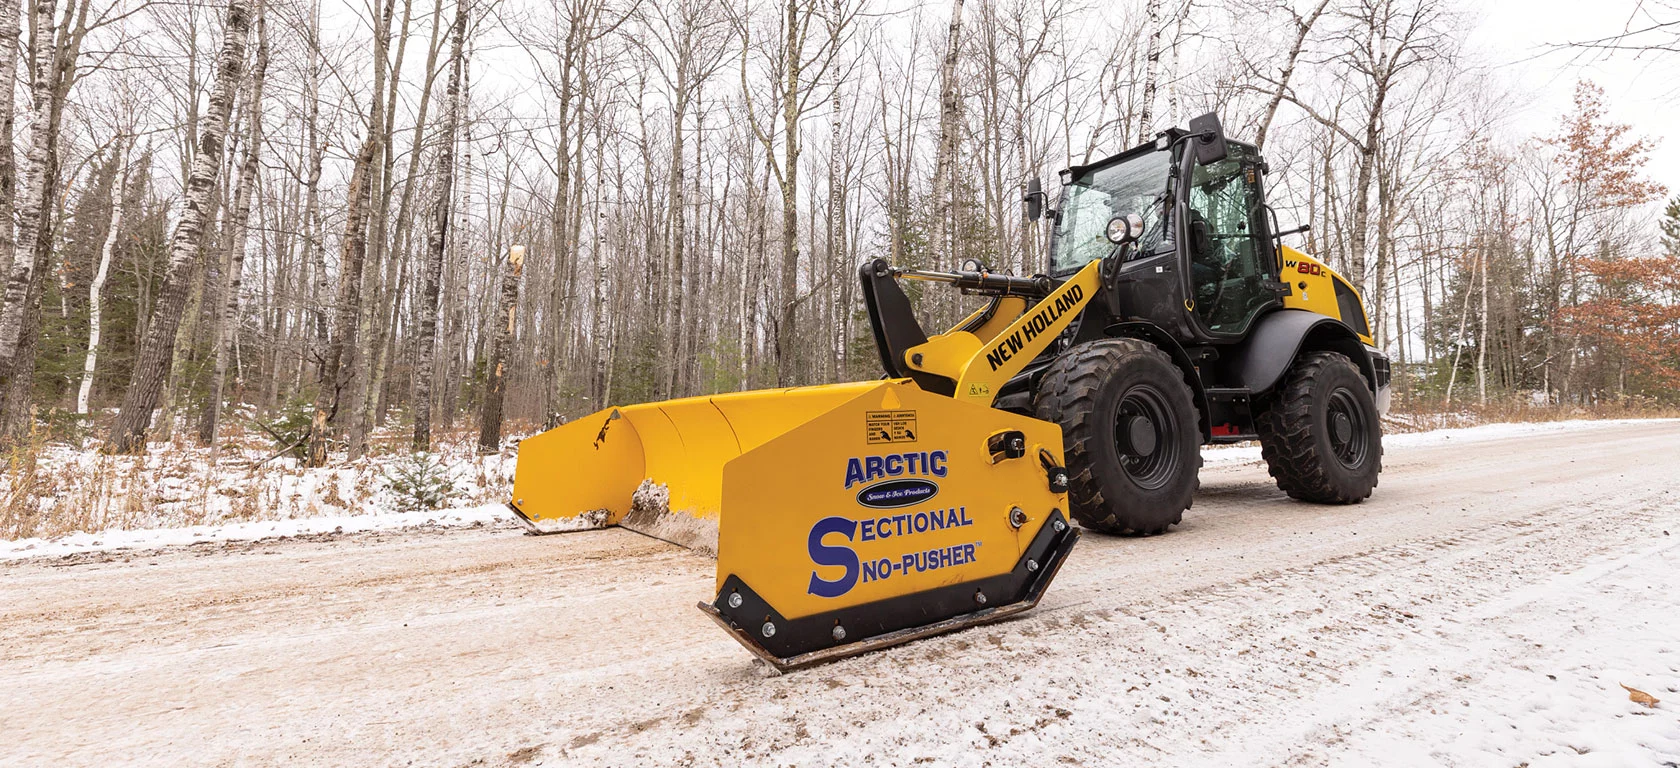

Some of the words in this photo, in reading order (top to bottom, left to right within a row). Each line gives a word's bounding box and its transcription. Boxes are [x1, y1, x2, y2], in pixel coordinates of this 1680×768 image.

[986, 330, 1024, 372] NEW
[1021, 283, 1084, 343] HOLLAND
[844, 450, 947, 489] ARCTIC
